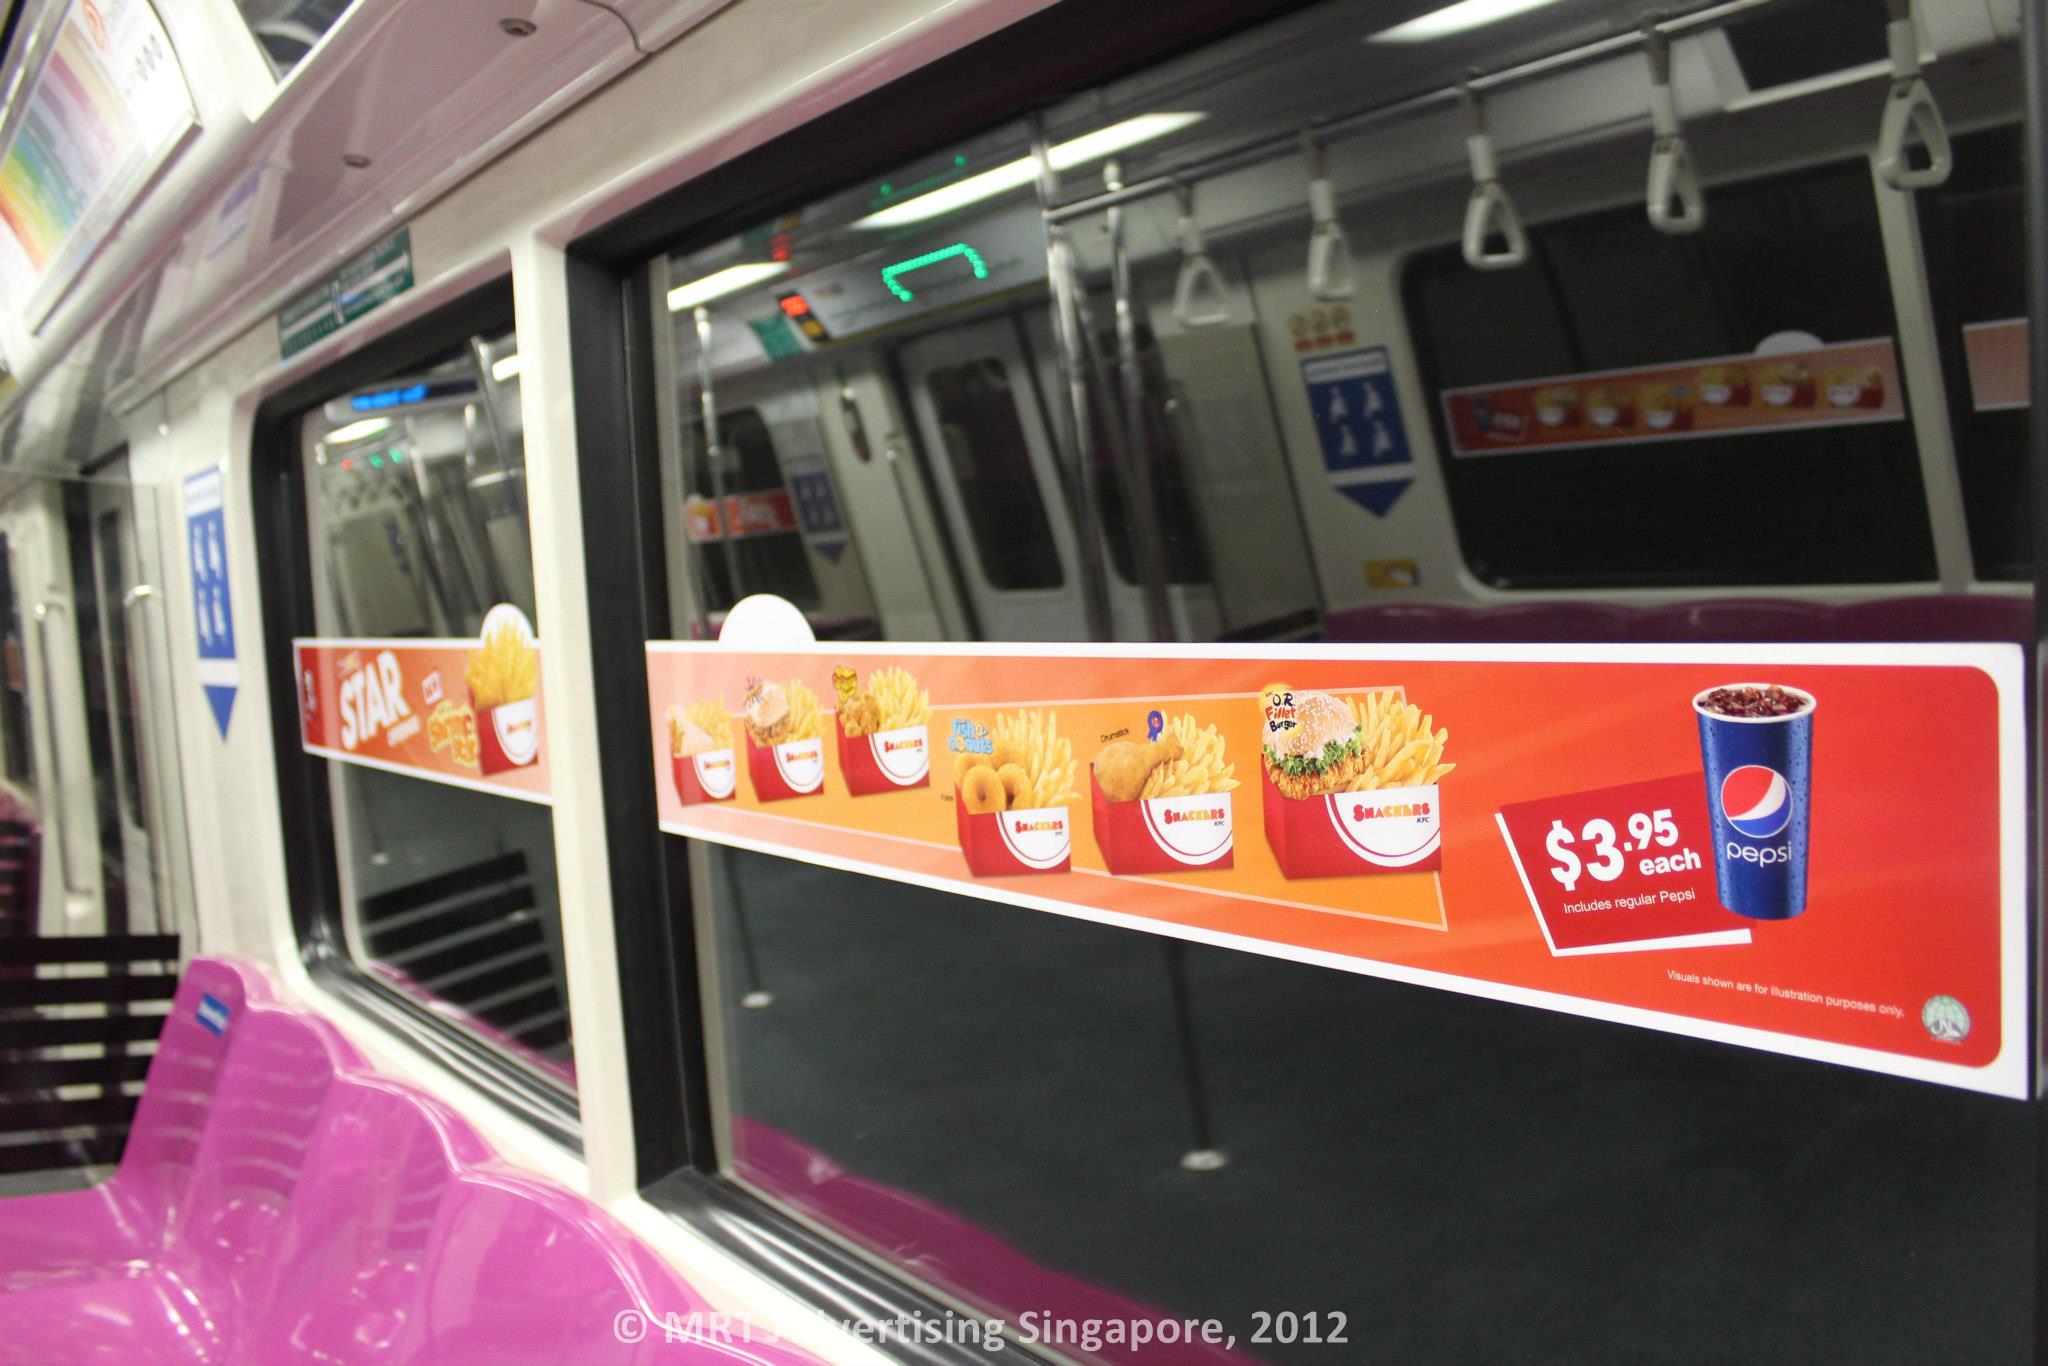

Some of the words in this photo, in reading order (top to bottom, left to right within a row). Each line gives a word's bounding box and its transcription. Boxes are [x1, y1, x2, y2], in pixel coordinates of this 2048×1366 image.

[340, 651, 411, 751] STAR
[1265, 706, 1297, 720] Fillet
[1100, 728, 1130, 743] Drumstick
[1270, 720, 1297, 732] Burger
[1416, 816, 1431, 824] KFC
[1546, 808, 1679, 892] $3.95
[1639, 847, 1702, 876] each
[1726, 840, 1793, 868] pepsi
[1563, 900, 1612, 914] Includes
[1614, 893, 1656, 910] regular
[1659, 887, 1696, 905] Pepsi
[1666, 969, 1700, 984] Visuals
[1702, 976, 1734, 989] shown
[1736, 982, 1752, 992] are
[1754, 983, 1769, 994] for
[1770, 986, 1823, 1003] illustration
[1826, 996, 1876, 1011] purposes
[1879, 1003, 1905, 1019] only.
